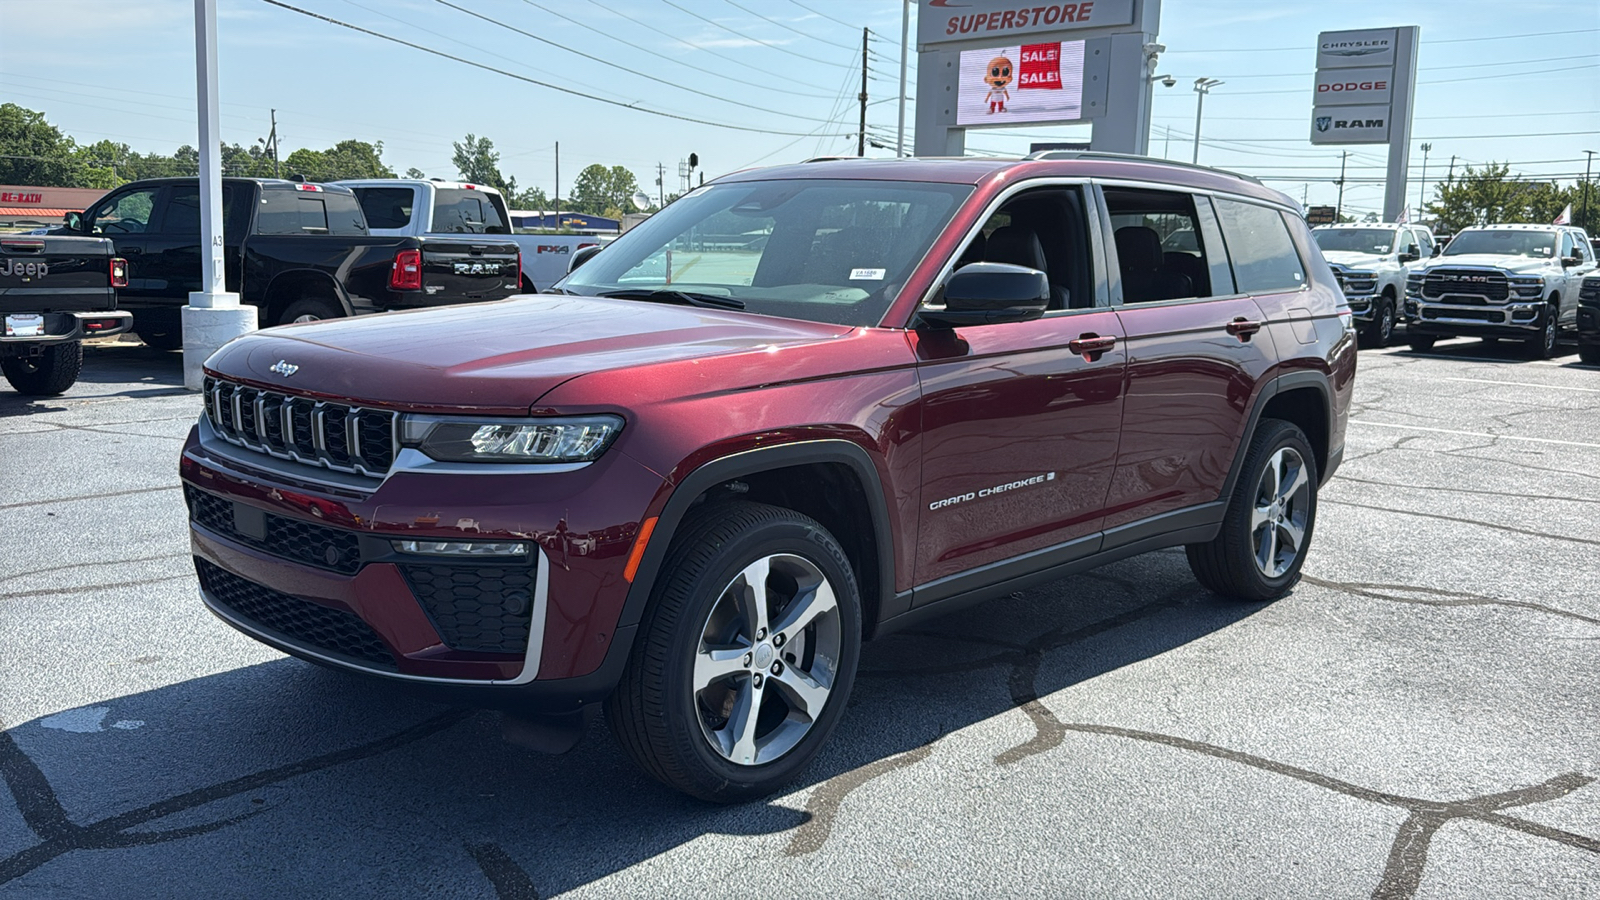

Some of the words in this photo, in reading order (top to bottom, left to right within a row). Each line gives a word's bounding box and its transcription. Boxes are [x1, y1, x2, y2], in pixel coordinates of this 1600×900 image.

[946, 2, 1094, 35] SUPERSTORE
[1322, 40, 1388, 49] CHRYSLER
[1021, 50, 1058, 62] SALE!
[1020, 71, 1059, 83] SALE!
[1317, 81, 1387, 92] DODGE
[1334, 119, 1384, 129] RAM
[1, 192, 42, 203] RE-BATH
[213, 235, 222, 247] A3
[537, 245, 569, 254] FX4
[0, 259, 48, 279] Jeep
[454, 263, 499, 274] RAM
[270, 360, 298, 377] Jeep
[929, 492, 975, 511] GRAND
[978, 475, 1044, 498] CHEROKEE
